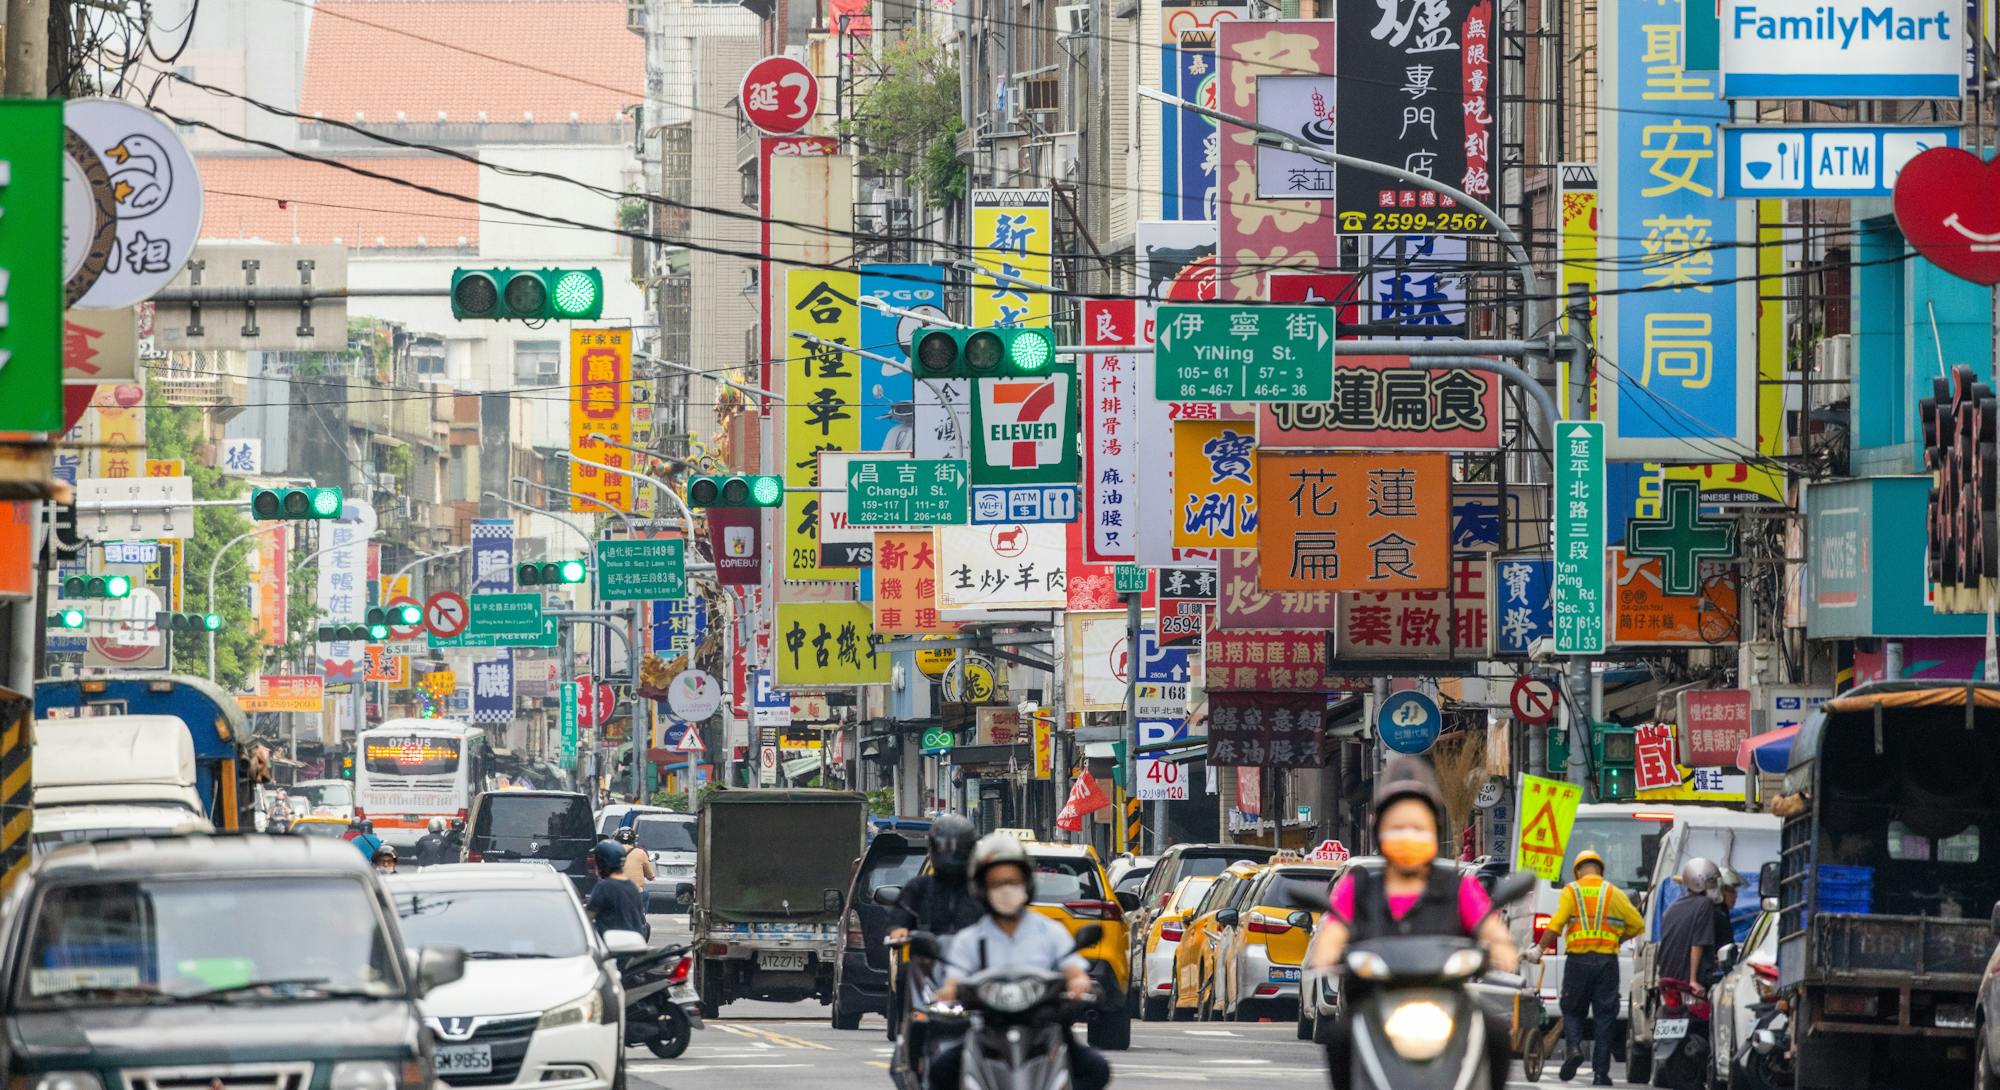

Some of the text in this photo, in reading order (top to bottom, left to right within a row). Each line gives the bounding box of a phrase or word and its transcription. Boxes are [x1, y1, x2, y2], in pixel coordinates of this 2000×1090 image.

[1733, 6, 1951, 50] FamilyMart
[1461, 16, 1493, 196] 無限量吃到飽
[1818, 146, 1870, 177] ATM
[1371, 213, 1489, 231] 2599-2567
[1096, 309, 1122, 342] 良
[1172, 312, 1318, 341] 伊寧街
[1193, 346, 1296, 364] YiNing St.
[225, 442, 257, 472] 德
[1101, 355, 1123, 548] 原汁排骨湯 麻油腰只
[1203, 430, 1256, 484] 寶
[858, 463, 956, 483] 昌吉街
[866, 485, 947, 499] ChangJi St.
[1013, 493, 1037, 502] ATM
[1288, 468, 1418, 518] 花蓮
[1569, 439, 1590, 561] 延平北路三段
[1699, 492, 1759, 502] HINESE HERB
[862, 500, 899, 509] 159-117
[978, 500, 1003, 511] Wi-Fi
[861, 512, 900, 521] 262-214
[913, 512, 953, 521] 206-148
[720, 558, 760, 568] COMEBUY
[1289, 531, 1419, 581] 扁食
[1557, 562, 1578, 574] Yan
[950, 562, 1068, 595] 生炒羊肉
[1557, 574, 1583, 588] Ping
[1557, 589, 1597, 601] N. Rd.
[1557, 602, 1595, 614] Sec. 3
[1162, 617, 1202, 634] 2594
[1160, 685, 1186, 700] 168
[388, 738, 431, 748] 076-U5
[1146, 760, 1179, 785] 40
[1315, 851, 1348, 861] 55178
